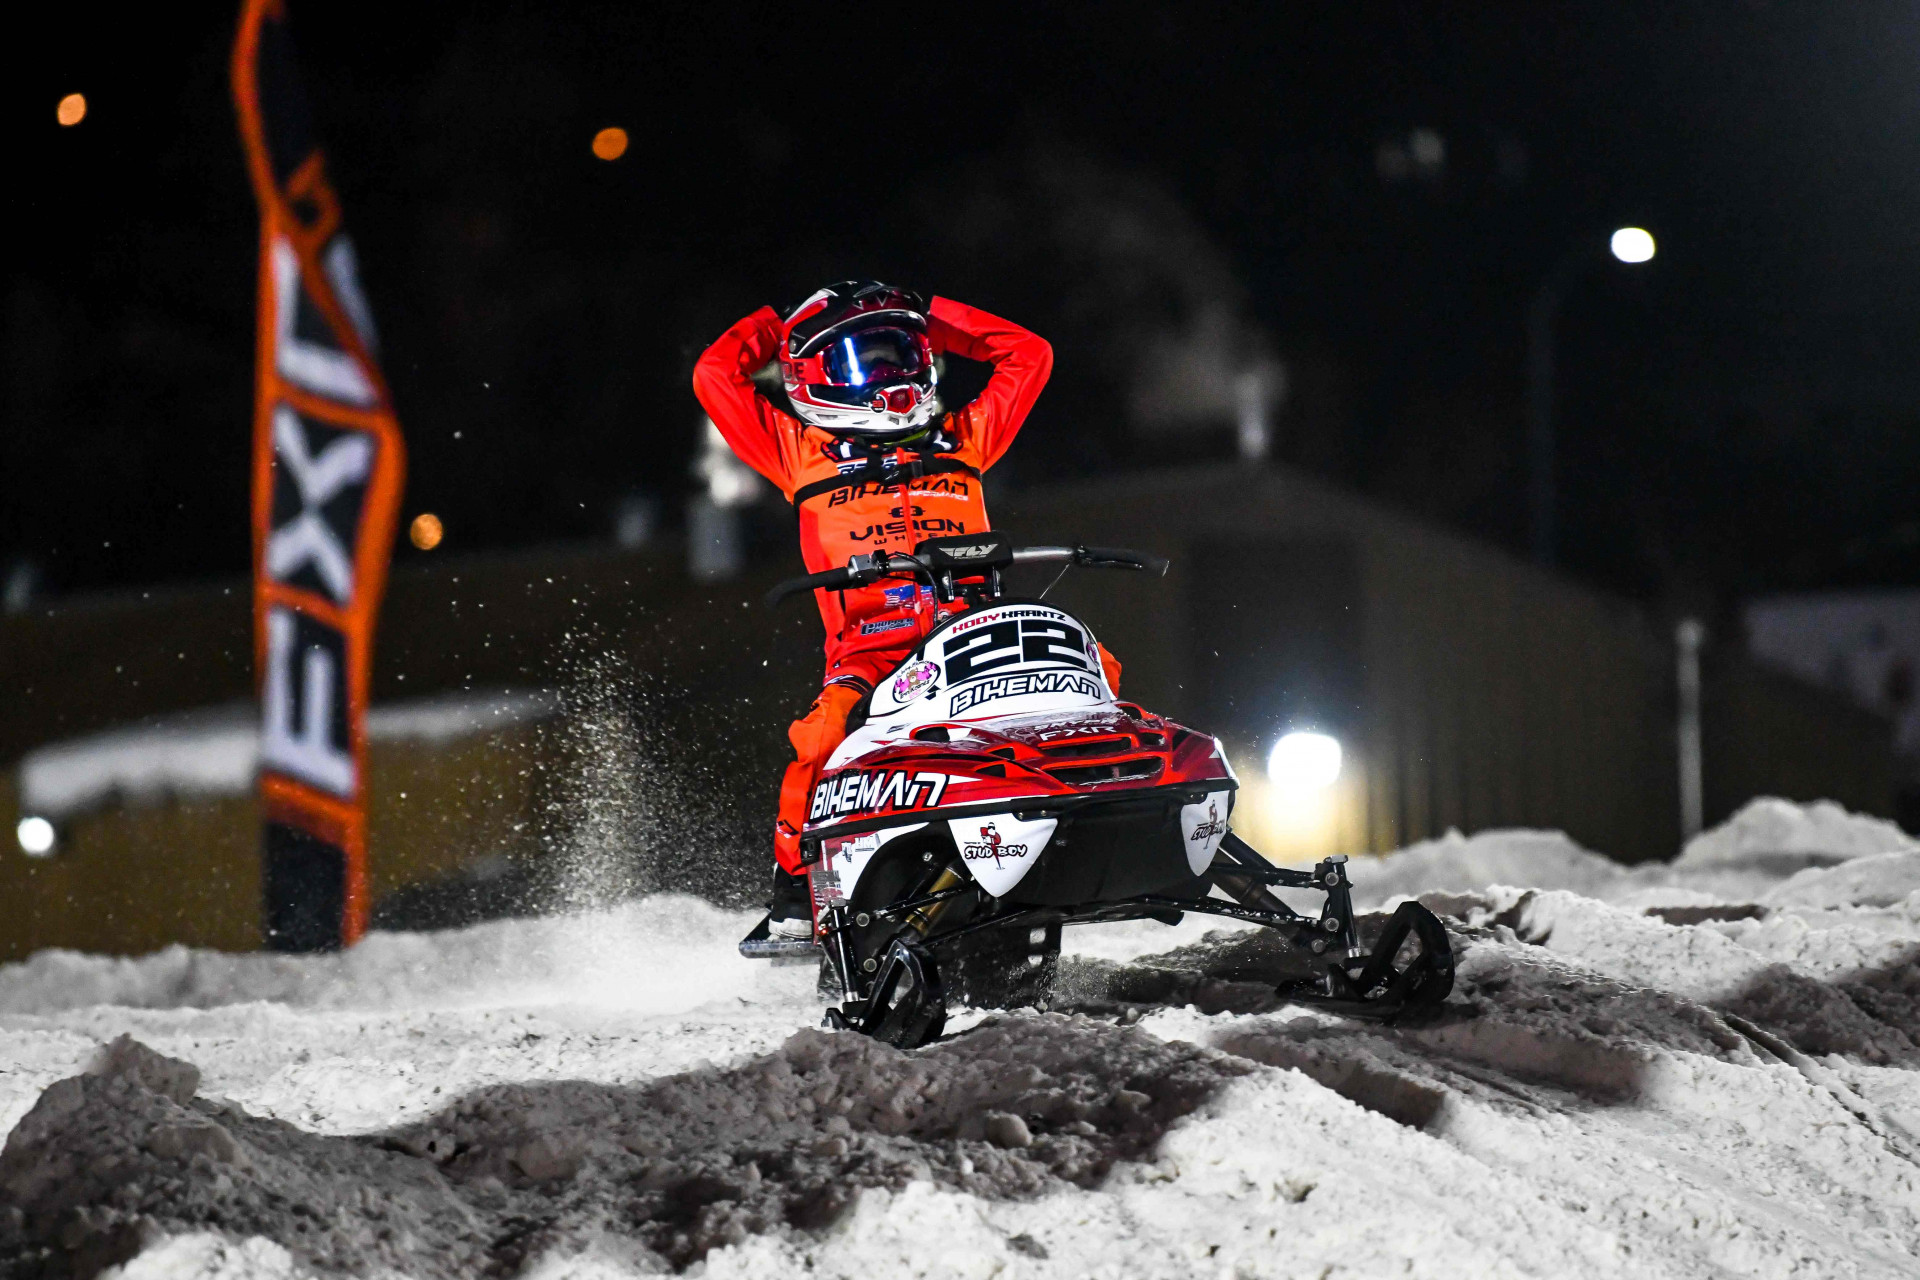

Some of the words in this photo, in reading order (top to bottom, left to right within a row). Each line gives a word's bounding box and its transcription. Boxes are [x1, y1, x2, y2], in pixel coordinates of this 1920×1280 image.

[850, 518, 965, 541] VISION
[938, 543, 999, 557] FLY
[952, 613, 1000, 634] KODY
[1001, 610, 1066, 622] KRANTZ
[942, 618, 1088, 687] 22
[950, 673, 1101, 719] BIKEMAN
[1041, 726, 1117, 741] FXR
[809, 769, 950, 822] BIKEMAN
[964, 845, 994, 859] STUD
[996, 844, 1028, 858] BOY
